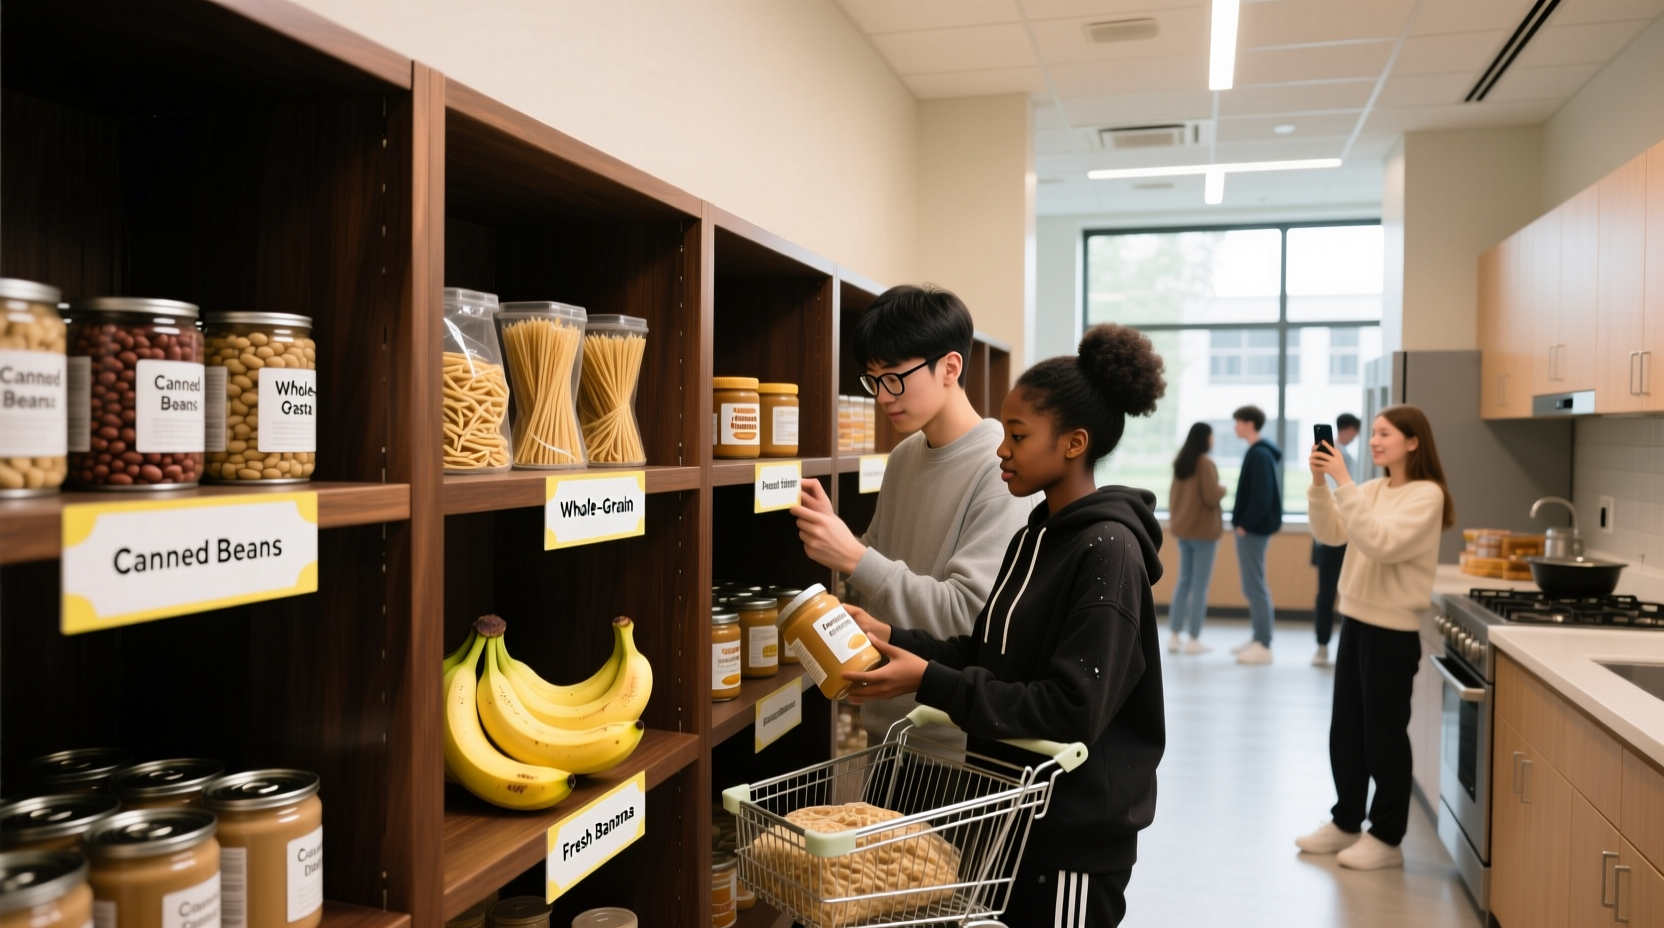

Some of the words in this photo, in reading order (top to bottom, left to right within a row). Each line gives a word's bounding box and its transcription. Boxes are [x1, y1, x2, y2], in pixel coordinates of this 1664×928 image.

[154, 374, 201, 392] Canned
[560, 495, 634, 518] Whole-Grain
[113, 539, 209, 575] Canned
[217, 538, 283, 563] Beans
[563, 828, 592, 862] Fresh
